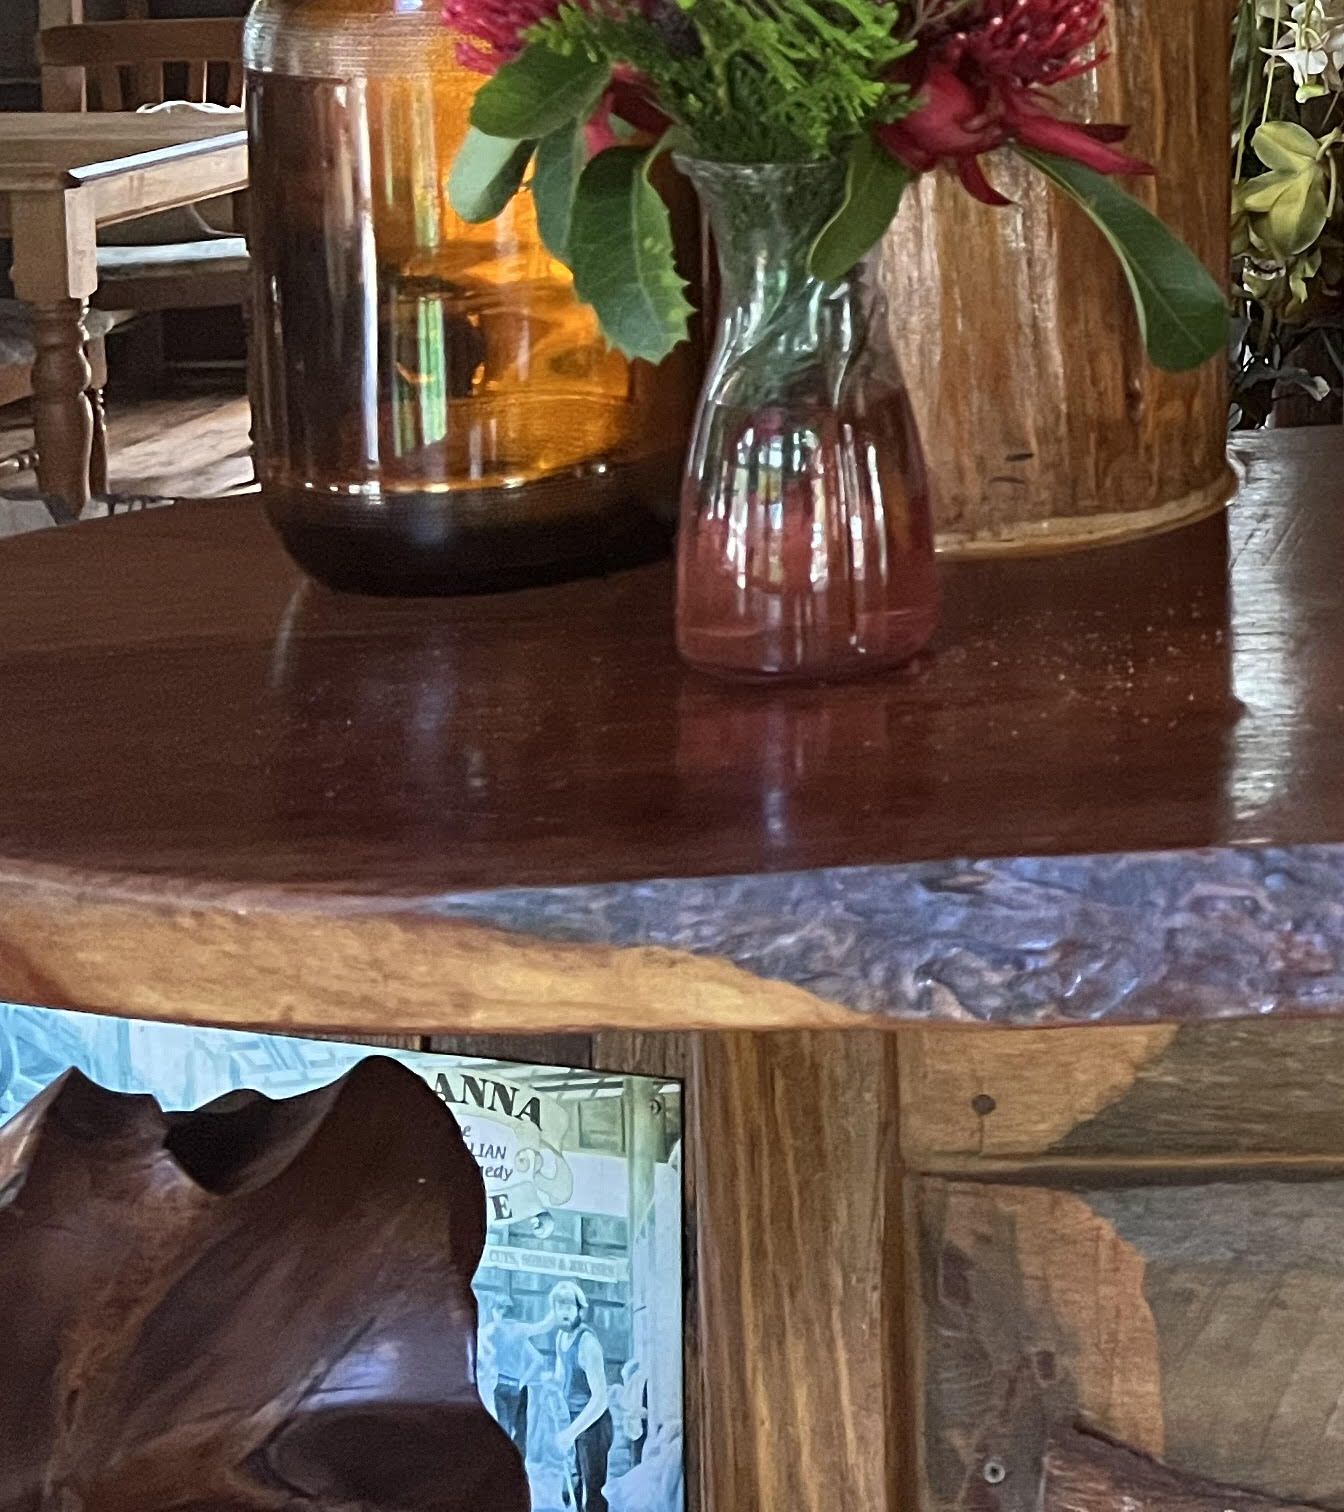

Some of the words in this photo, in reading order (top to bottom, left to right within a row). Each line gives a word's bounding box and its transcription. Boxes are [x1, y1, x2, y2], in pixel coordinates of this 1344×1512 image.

[435, 1072, 543, 1132] ANNA
[470, 1142, 508, 1160] LIAN
[480, 1164, 514, 1182] edy
[488, 1193, 513, 1221] E
